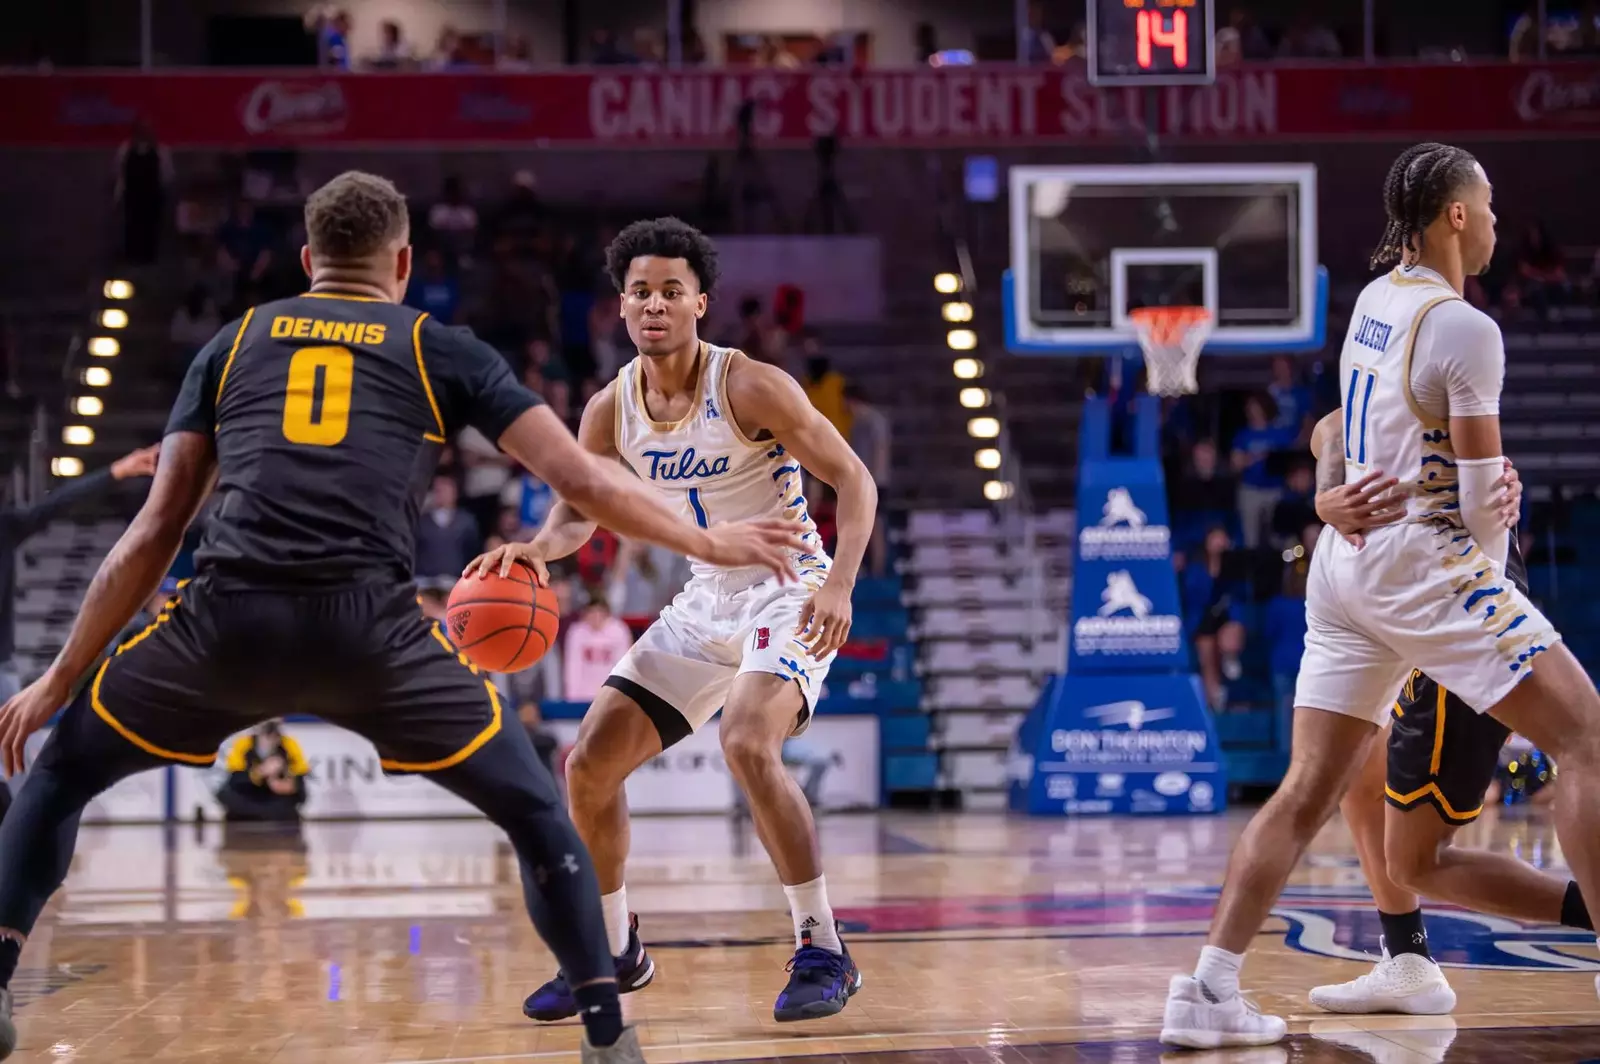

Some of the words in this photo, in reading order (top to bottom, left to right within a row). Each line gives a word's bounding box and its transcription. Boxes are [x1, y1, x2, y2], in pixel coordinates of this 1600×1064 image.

[1137, 8, 1187, 69] 14
[588, 76, 783, 138] CANIAC
[806, 75, 1044, 137] STUDENT
[270, 316, 387, 345] DENNIS
[1354, 314, 1393, 353] JACKSON
[282, 345, 354, 446] 0
[1344, 366, 1377, 467] 11
[642, 447, 730, 481] Tulsa
[686, 487, 709, 529] 1
